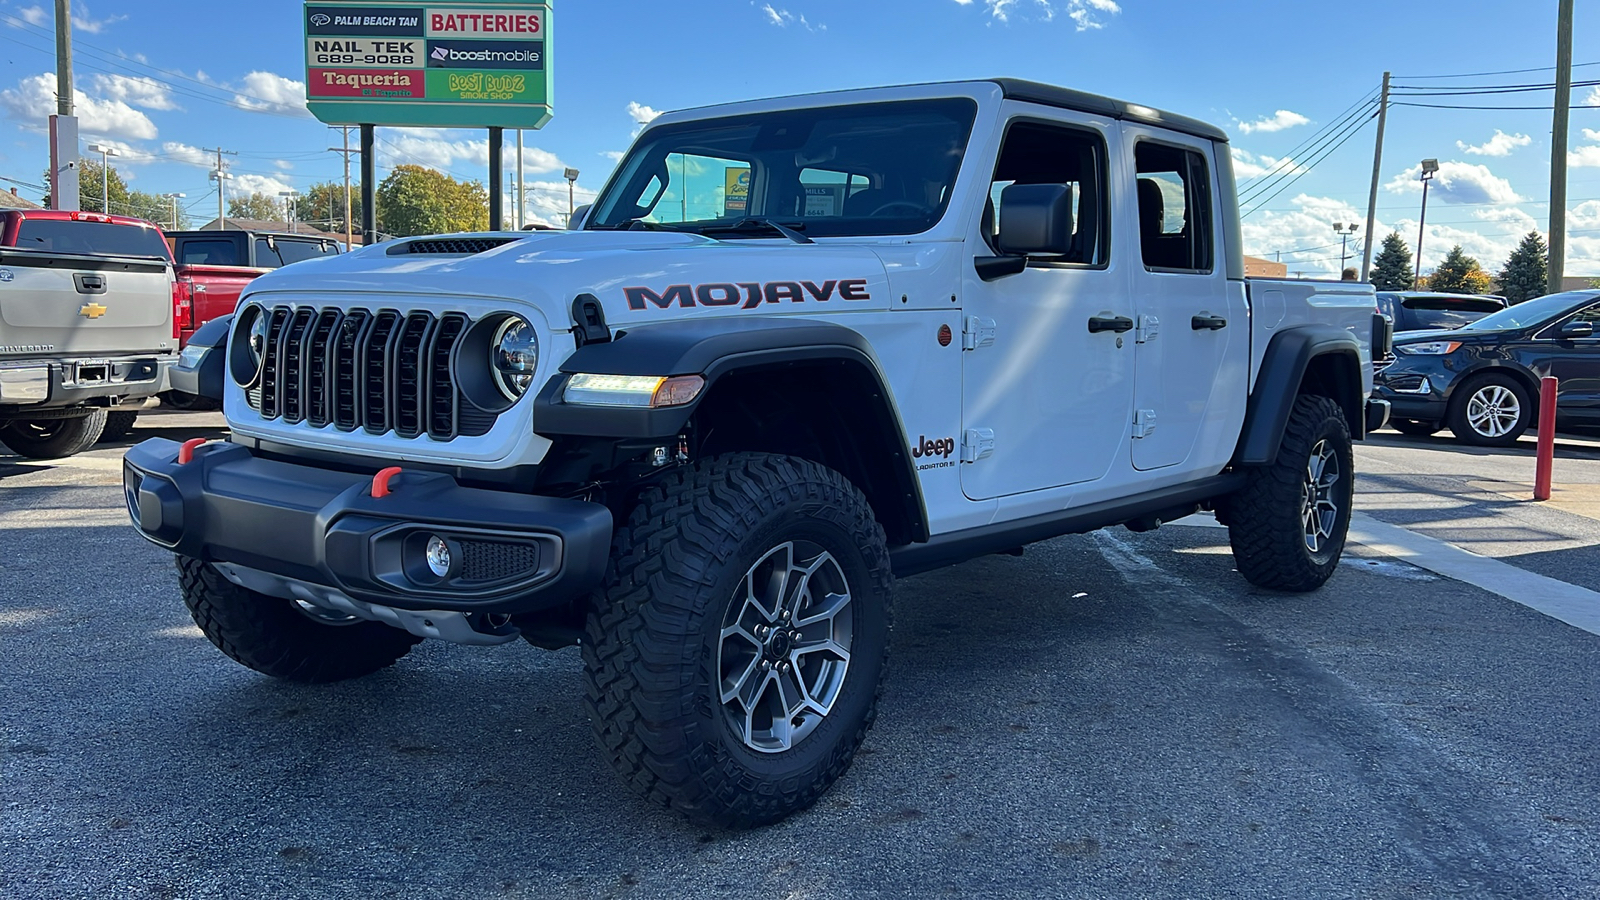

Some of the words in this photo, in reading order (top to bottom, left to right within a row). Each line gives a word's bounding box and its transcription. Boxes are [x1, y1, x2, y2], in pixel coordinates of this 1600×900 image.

[334, 16, 361, 25] PALM
[363, 16, 396, 26] BEACH
[398, 17, 418, 26] TAN
[431, 14, 540, 33] BATTERIES
[314, 41, 362, 53] NAIL
[371, 42, 415, 53] TEK
[317, 54, 414, 64] 689-9088
[490, 92, 514, 100] SHOP
[622, 279, 870, 310] MOJAVE
[912, 435, 955, 459] Jeep
